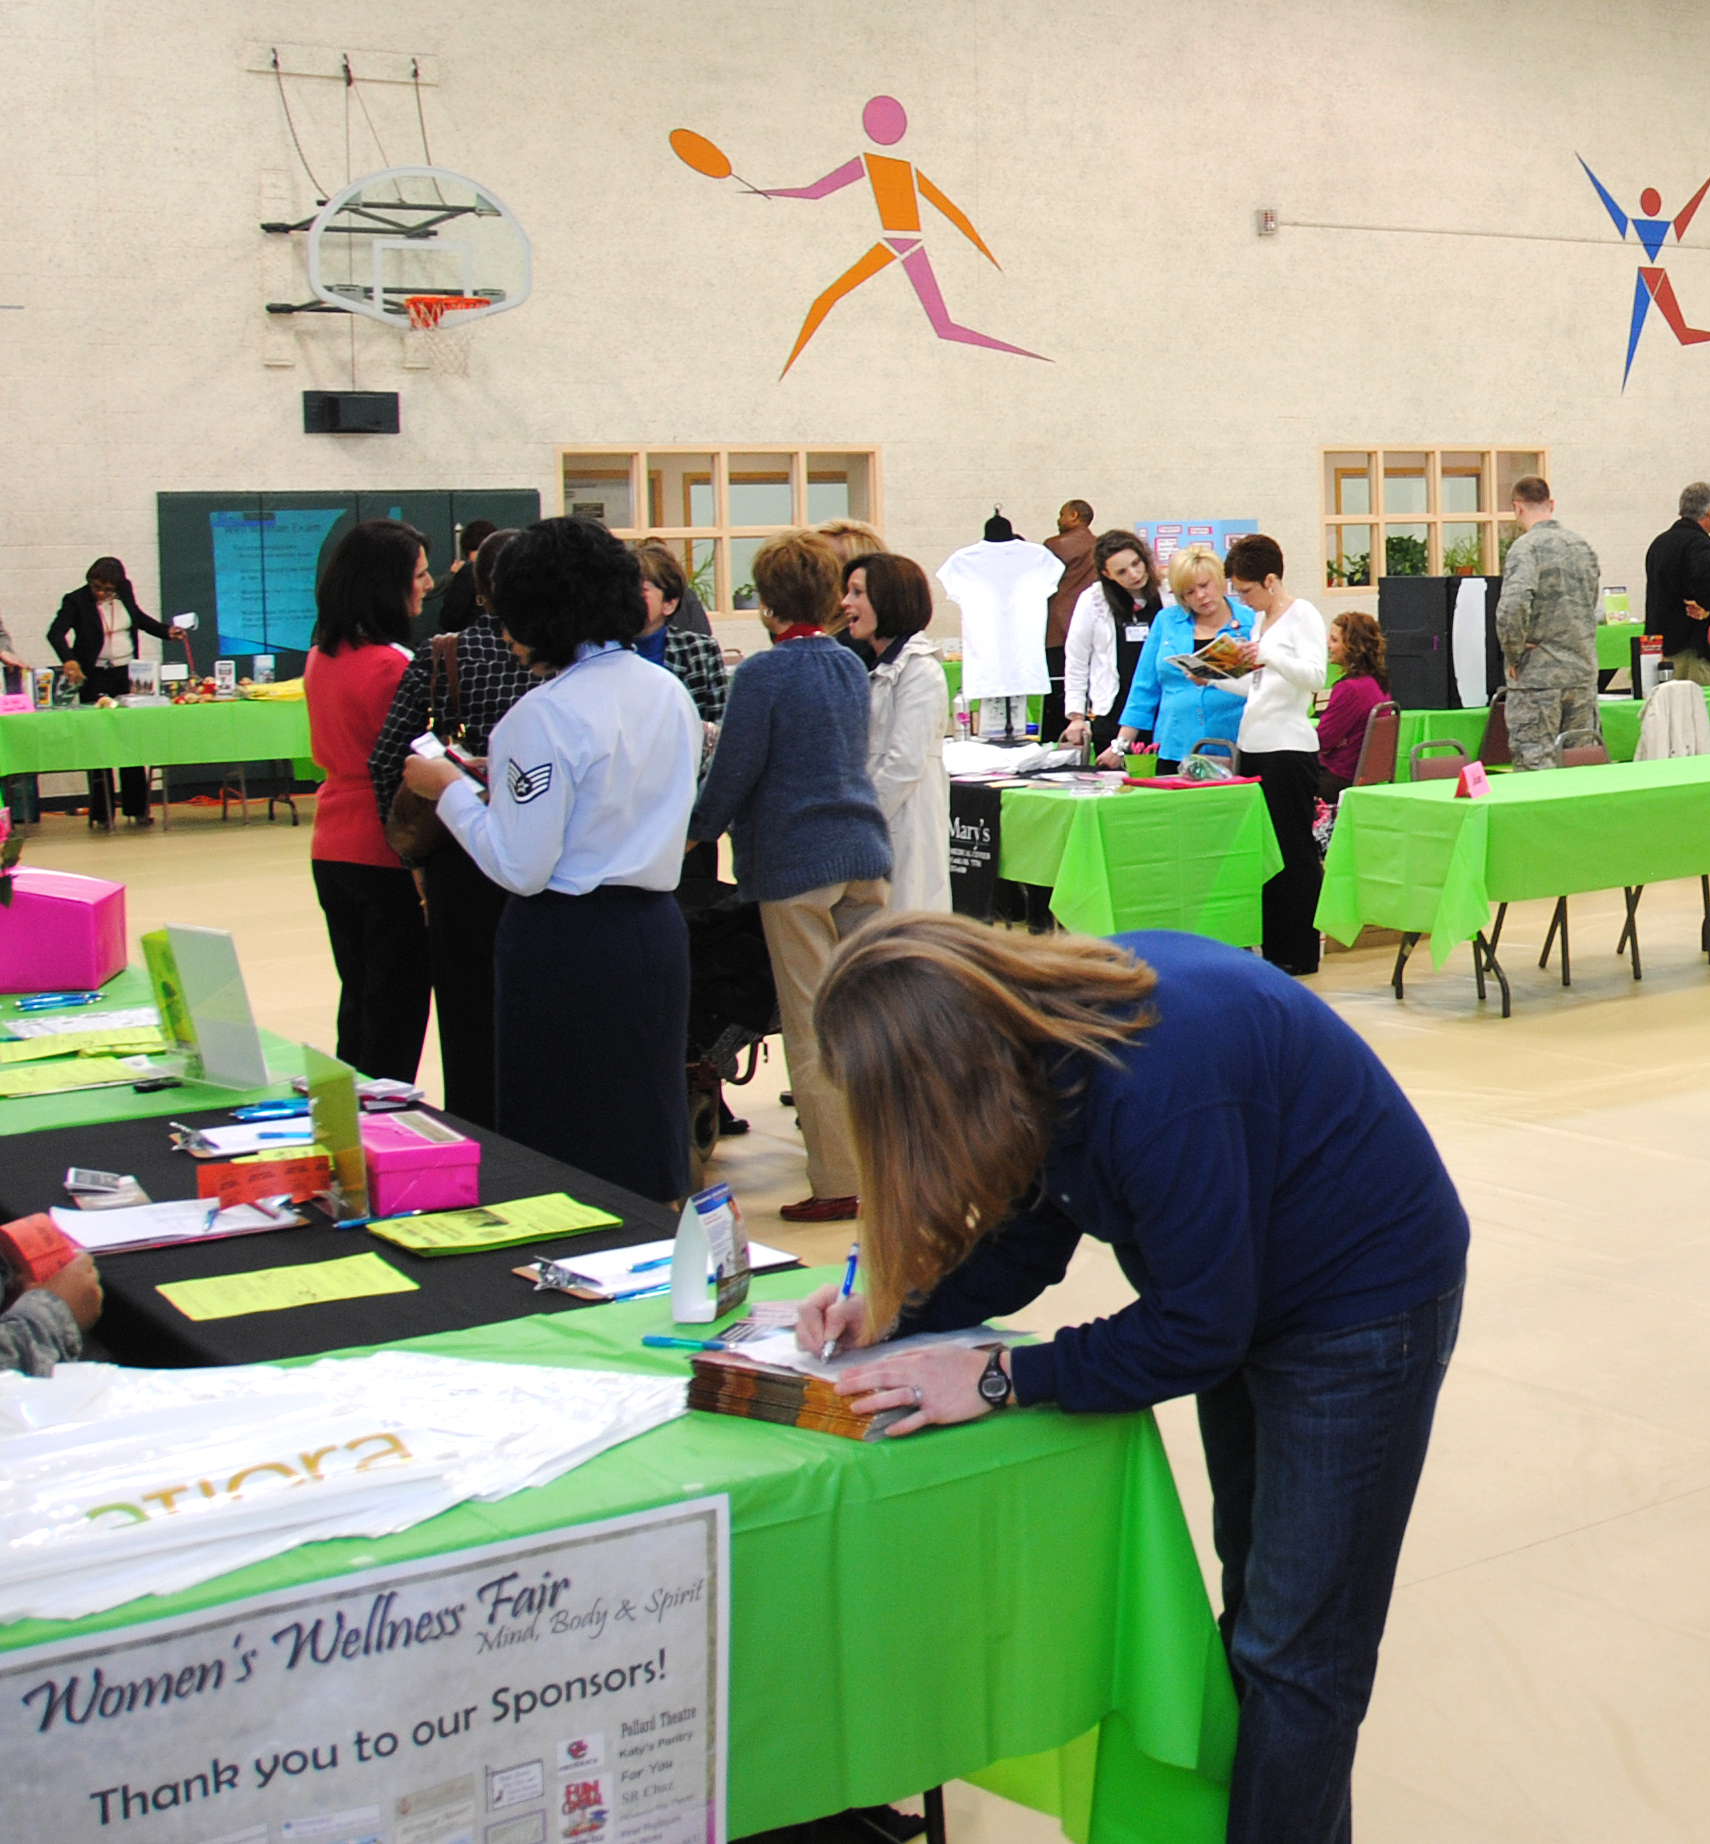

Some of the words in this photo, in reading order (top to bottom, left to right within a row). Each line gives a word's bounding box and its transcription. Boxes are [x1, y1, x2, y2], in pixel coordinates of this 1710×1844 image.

[475, 1612, 541, 1654] Mind,
[550, 1597, 608, 1640] Body
[614, 1599, 637, 1621] &
[644, 1578, 706, 1624] Spirit
[22, 1632, 257, 1733] Women's
[271, 1590, 467, 1670] Wellness
[476, 1571, 571, 1624] Fair
[90, 1758, 240, 1825] Thank
[254, 1744, 338, 1789] you
[353, 1730, 399, 1762] to
[412, 1704, 478, 1746] our
[492, 1647, 666, 1723] Sponsors!
[657, 1731, 693, 1749] Pantry
[659, 1706, 697, 1729] Theatre
[650, 1760, 674, 1775] You
